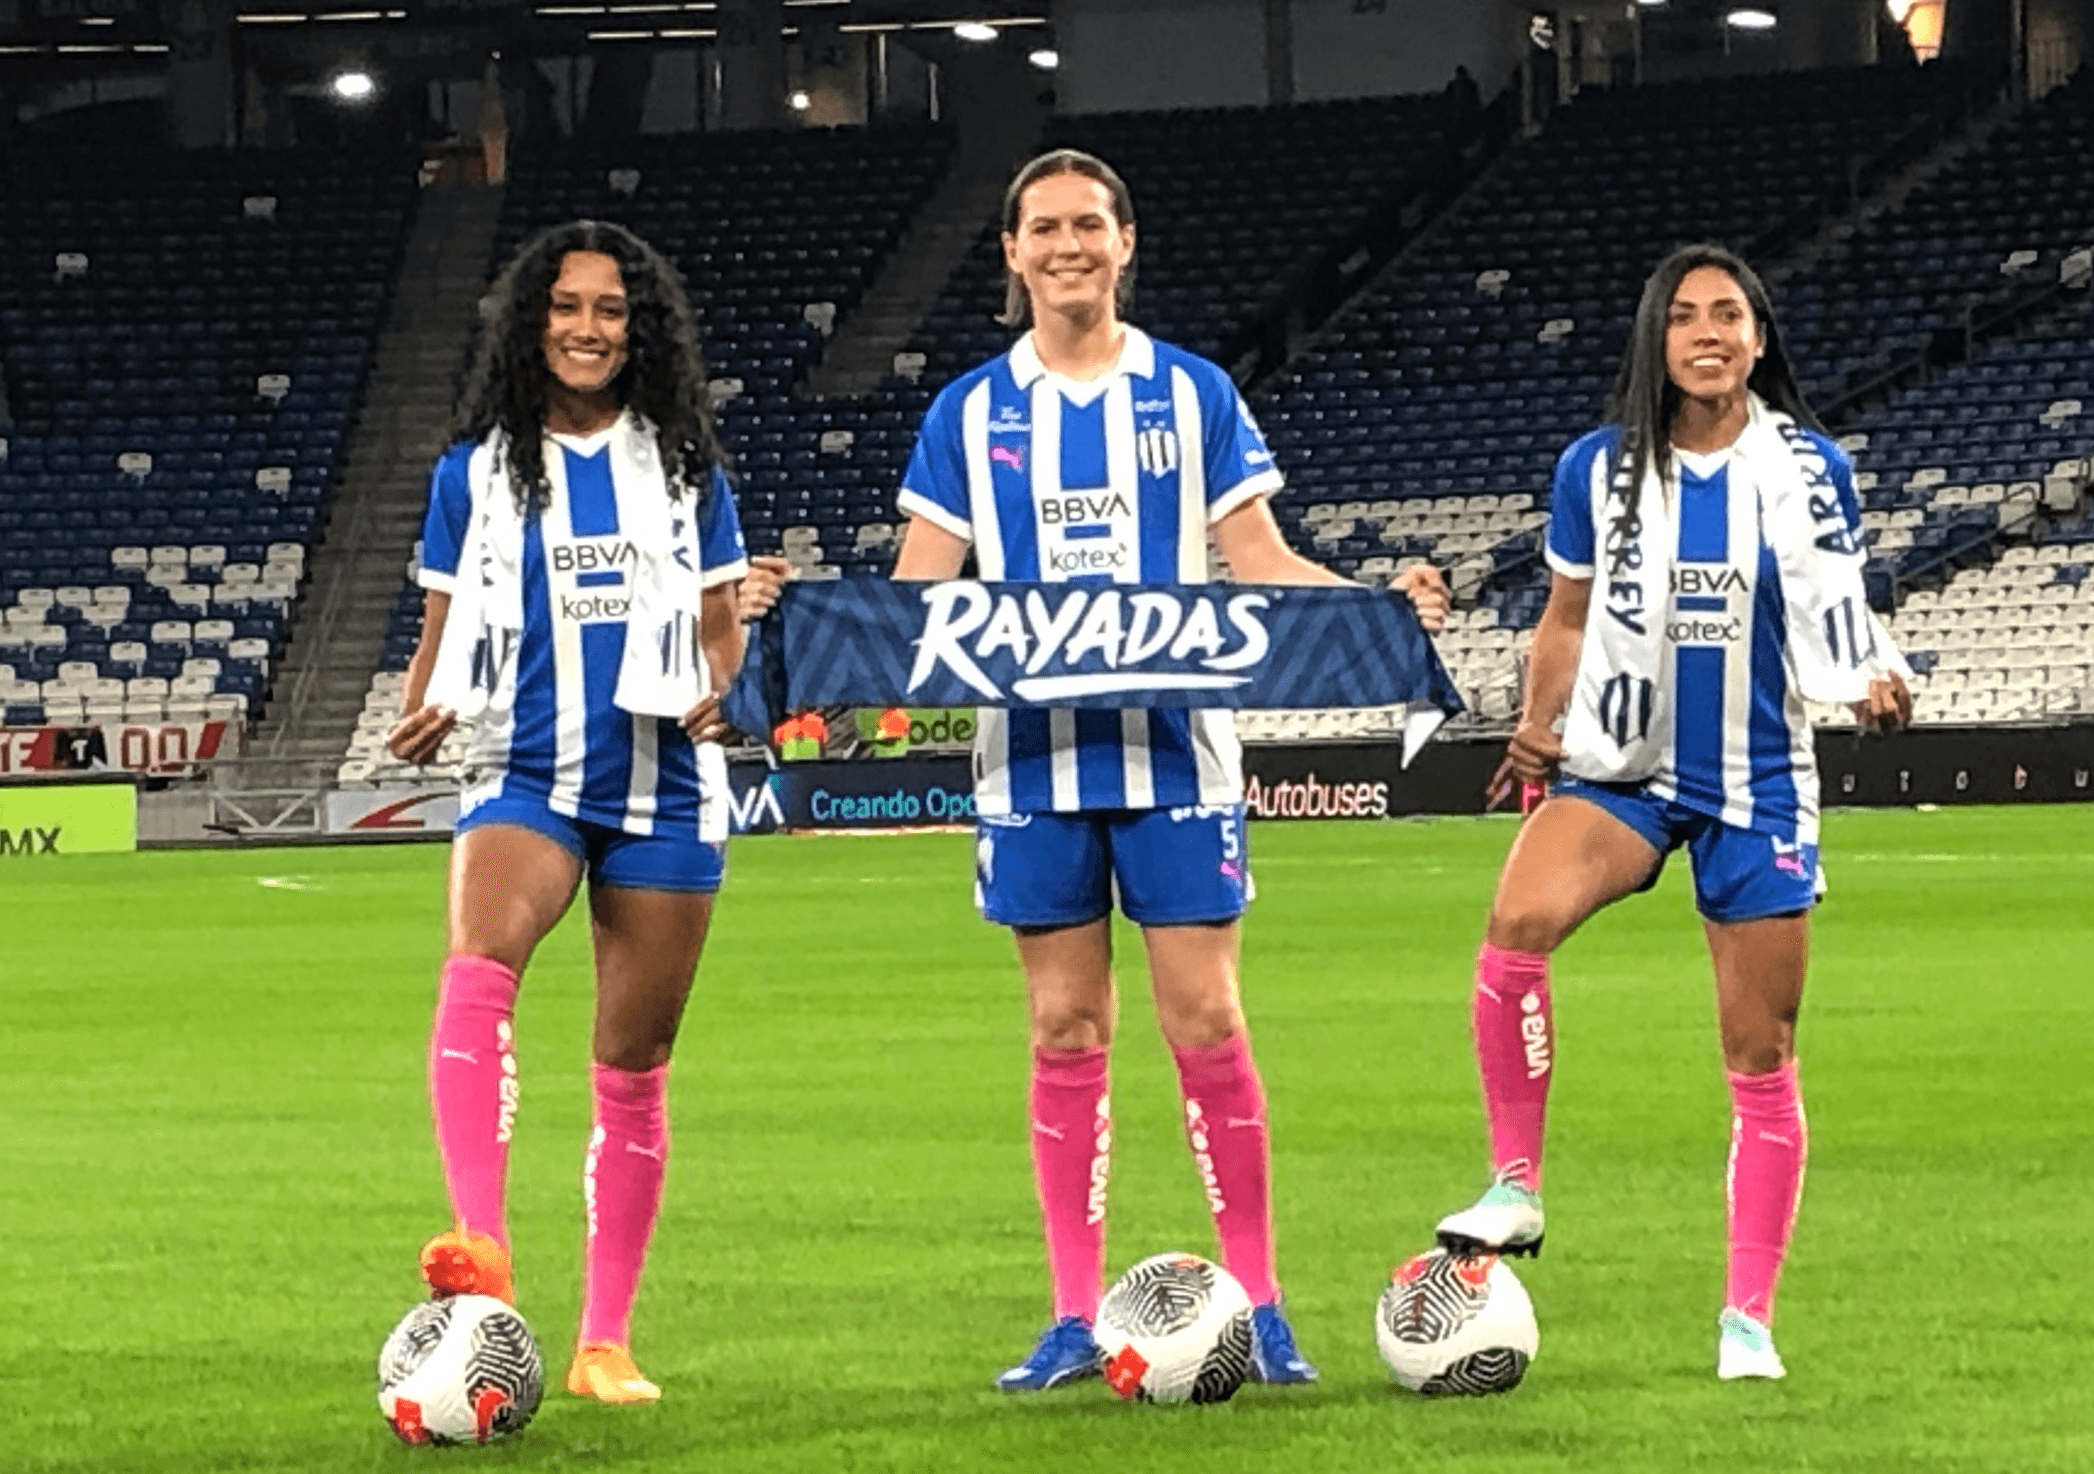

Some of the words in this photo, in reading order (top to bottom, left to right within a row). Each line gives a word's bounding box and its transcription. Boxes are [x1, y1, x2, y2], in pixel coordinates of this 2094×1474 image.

[1041, 492, 1131, 524] BBVA
[552, 540, 638, 572] BBVA
[1050, 545, 1126, 573] kotex
[906, 581, 1270, 700] RAYADAS
[811, 788, 920, 819] Creando
[1247, 772, 1388, 817] Autobuses
[1221, 820, 1238, 859] 5
